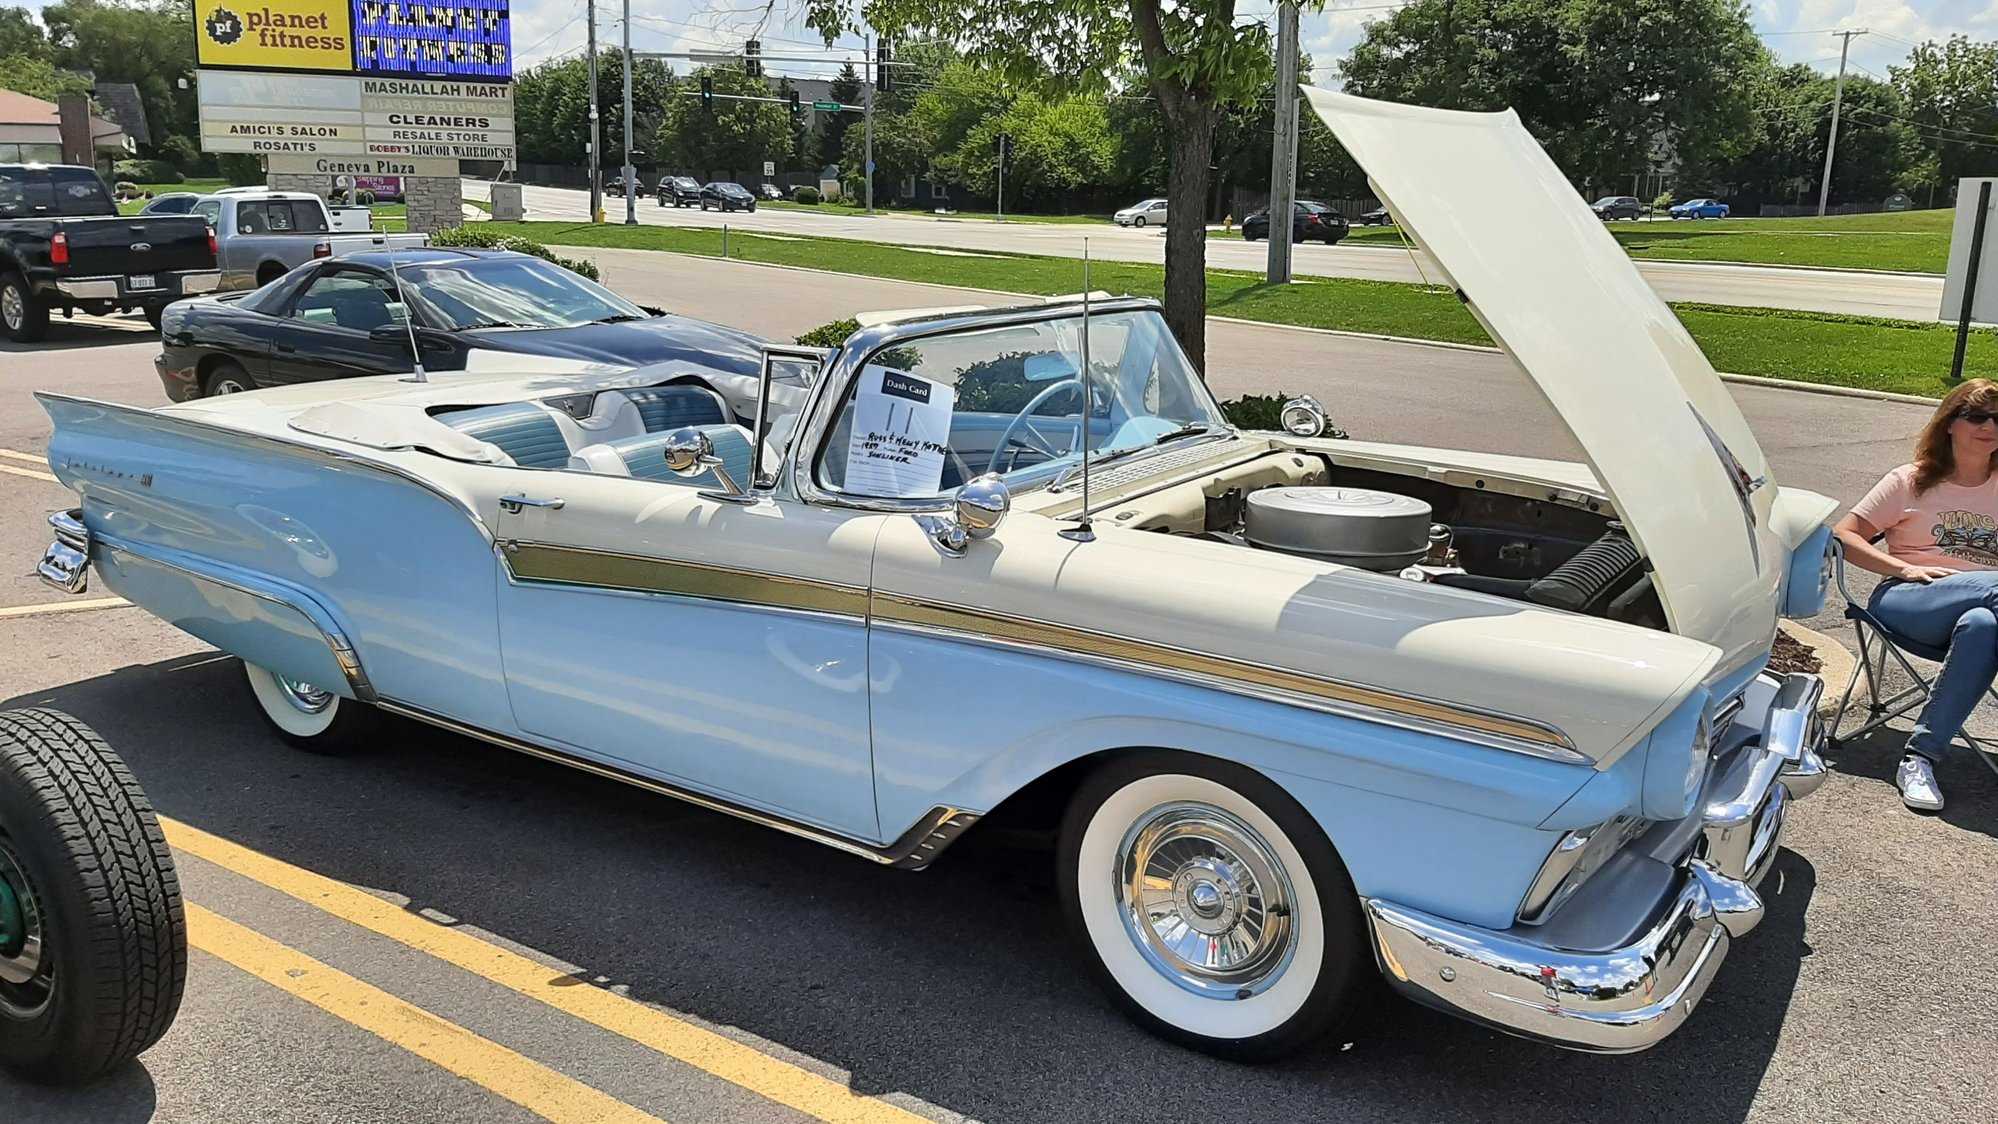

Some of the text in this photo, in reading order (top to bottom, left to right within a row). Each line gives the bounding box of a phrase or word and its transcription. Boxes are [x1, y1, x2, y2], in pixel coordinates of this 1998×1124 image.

[245, 7, 328, 31] planet
[214, 20, 232, 36] pf
[259, 28, 345, 51] fitness
[364, 81, 508, 98] MASHALLAH MART
[388, 114, 490, 128] CLEANERS
[229, 125, 338, 137] AMICI'S SALON
[392, 130, 489, 143] RESALE STORE
[253, 141, 317, 152] ROSATI'S
[369, 144, 513, 159] BOBBY'S LIQUOR WAREHOUSE
[316, 158, 416, 175] Geneva Plaza
[886, 379, 928, 397] Dash Card
